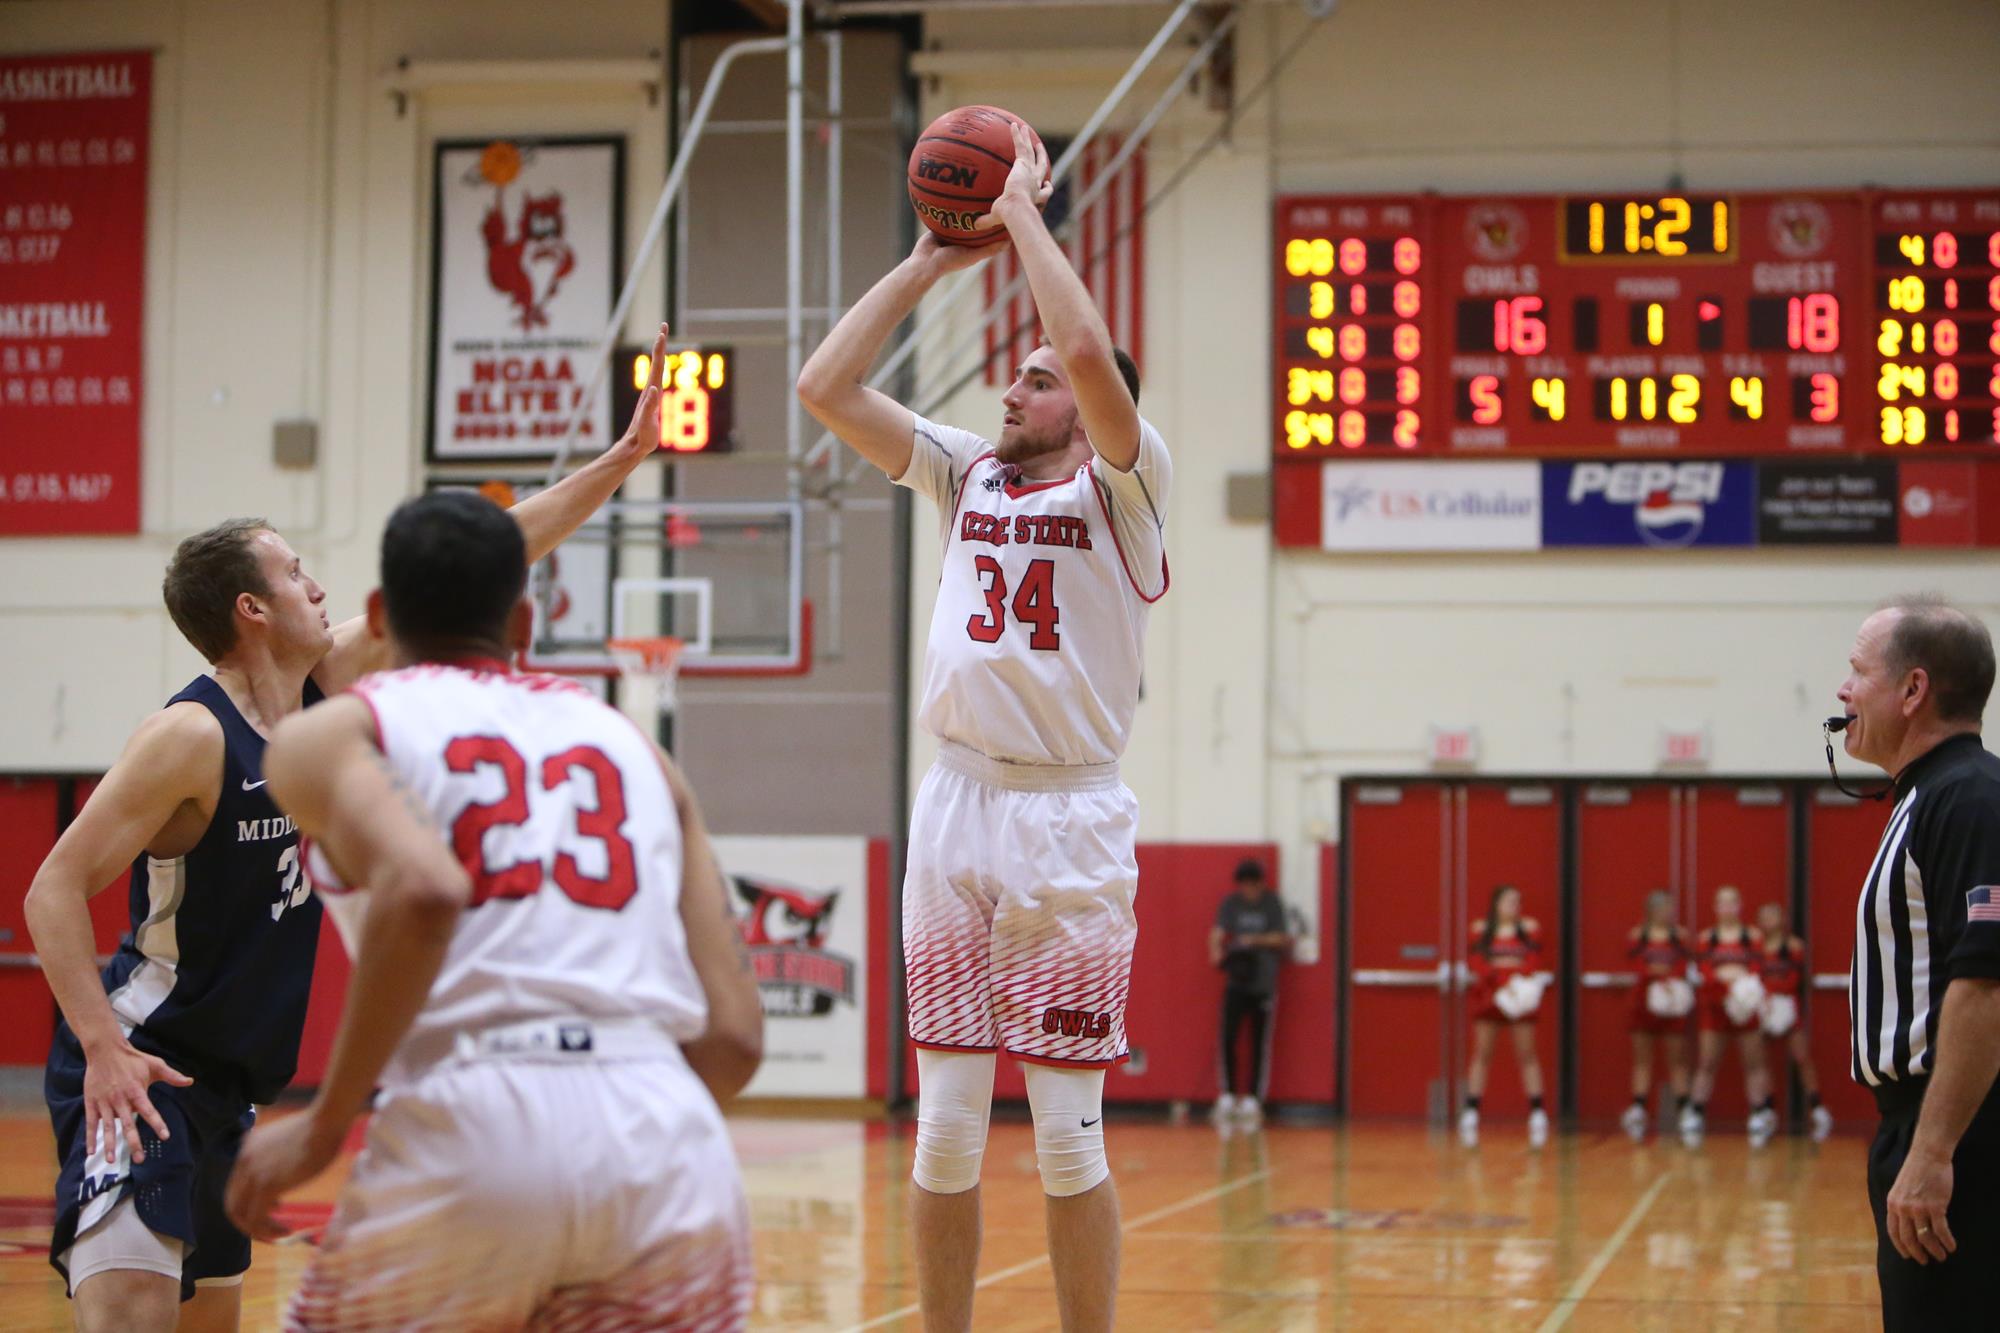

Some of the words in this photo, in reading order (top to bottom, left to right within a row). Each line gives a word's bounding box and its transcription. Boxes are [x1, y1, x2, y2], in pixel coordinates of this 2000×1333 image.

[1589, 198, 1728, 256] 11:21
[1900, 235, 1925, 266] 4
[1933, 232, 1957, 269] 0
[1351, 284, 1366, 316] 1
[1889, 275, 1925, 313] 10
[1945, 278, 1958, 310] 1
[1494, 296, 1546, 355] 16
[1647, 303, 1664, 346] 1
[1788, 293, 1839, 352] 18
[1878, 319, 1925, 357] 21
[1934, 319, 1958, 356] 0
[1470, 375, 1502, 424] 5
[1532, 378, 1565, 421] 4
[1730, 377, 1762, 420] 4
[1810, 373, 1838, 422] 3
[1934, 363, 1958, 400] 0
[1881, 407, 1925, 444] 33
[1945, 410, 1959, 441] 1
[1567, 462, 1725, 505] PEPSI
[1014, 515, 1092, 550] STATE
[966, 554, 1060, 651] 34
[237, 814, 298, 842] MIDD
[444, 735, 638, 912] 23
[1042, 1007, 1111, 1038] OWLS
